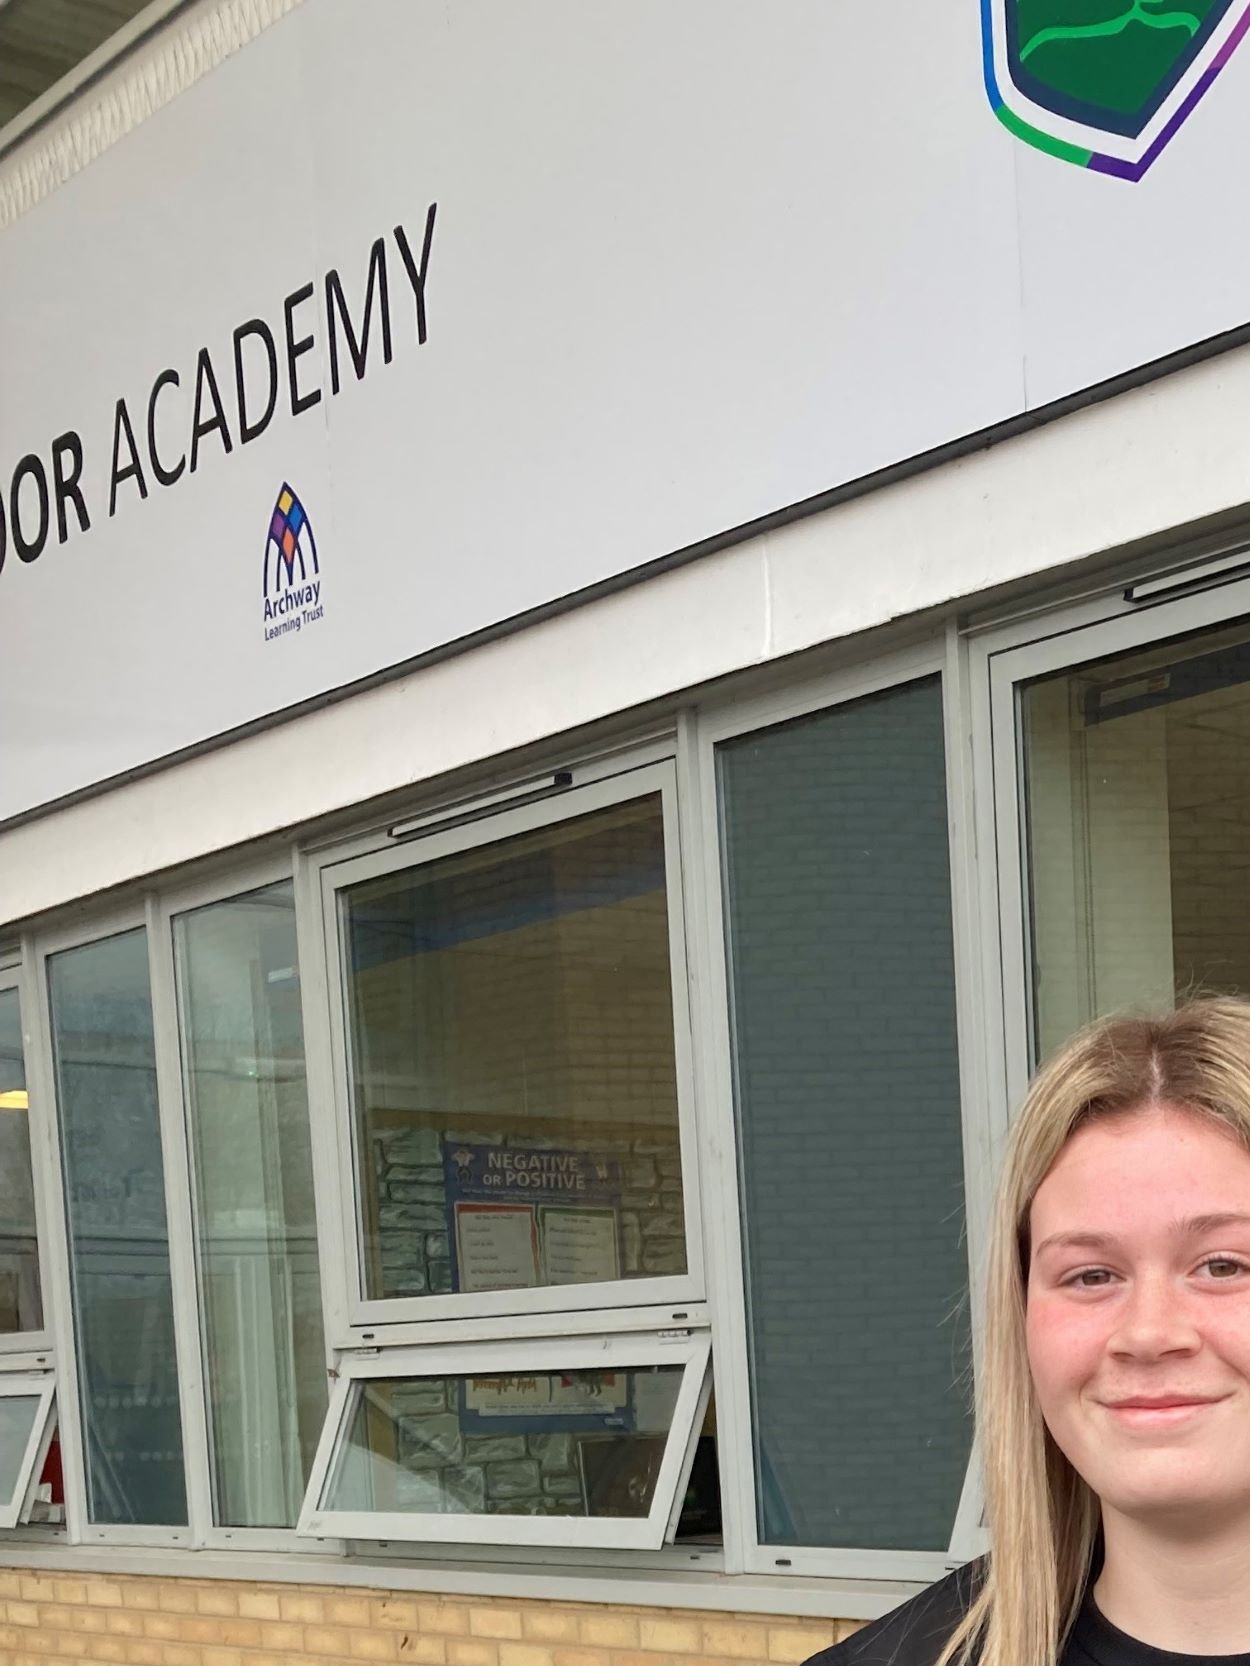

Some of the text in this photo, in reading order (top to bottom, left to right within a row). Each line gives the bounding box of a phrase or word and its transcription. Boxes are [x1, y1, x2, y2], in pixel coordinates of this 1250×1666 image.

[0, 201, 438, 576] OR ACADEMY
[263, 580, 321, 622] Archway
[264, 604, 324, 641] Learning Trust
[482, 1171, 587, 1190] OR POSITIVE
[487, 1152, 579, 1172] NEGATIVE
